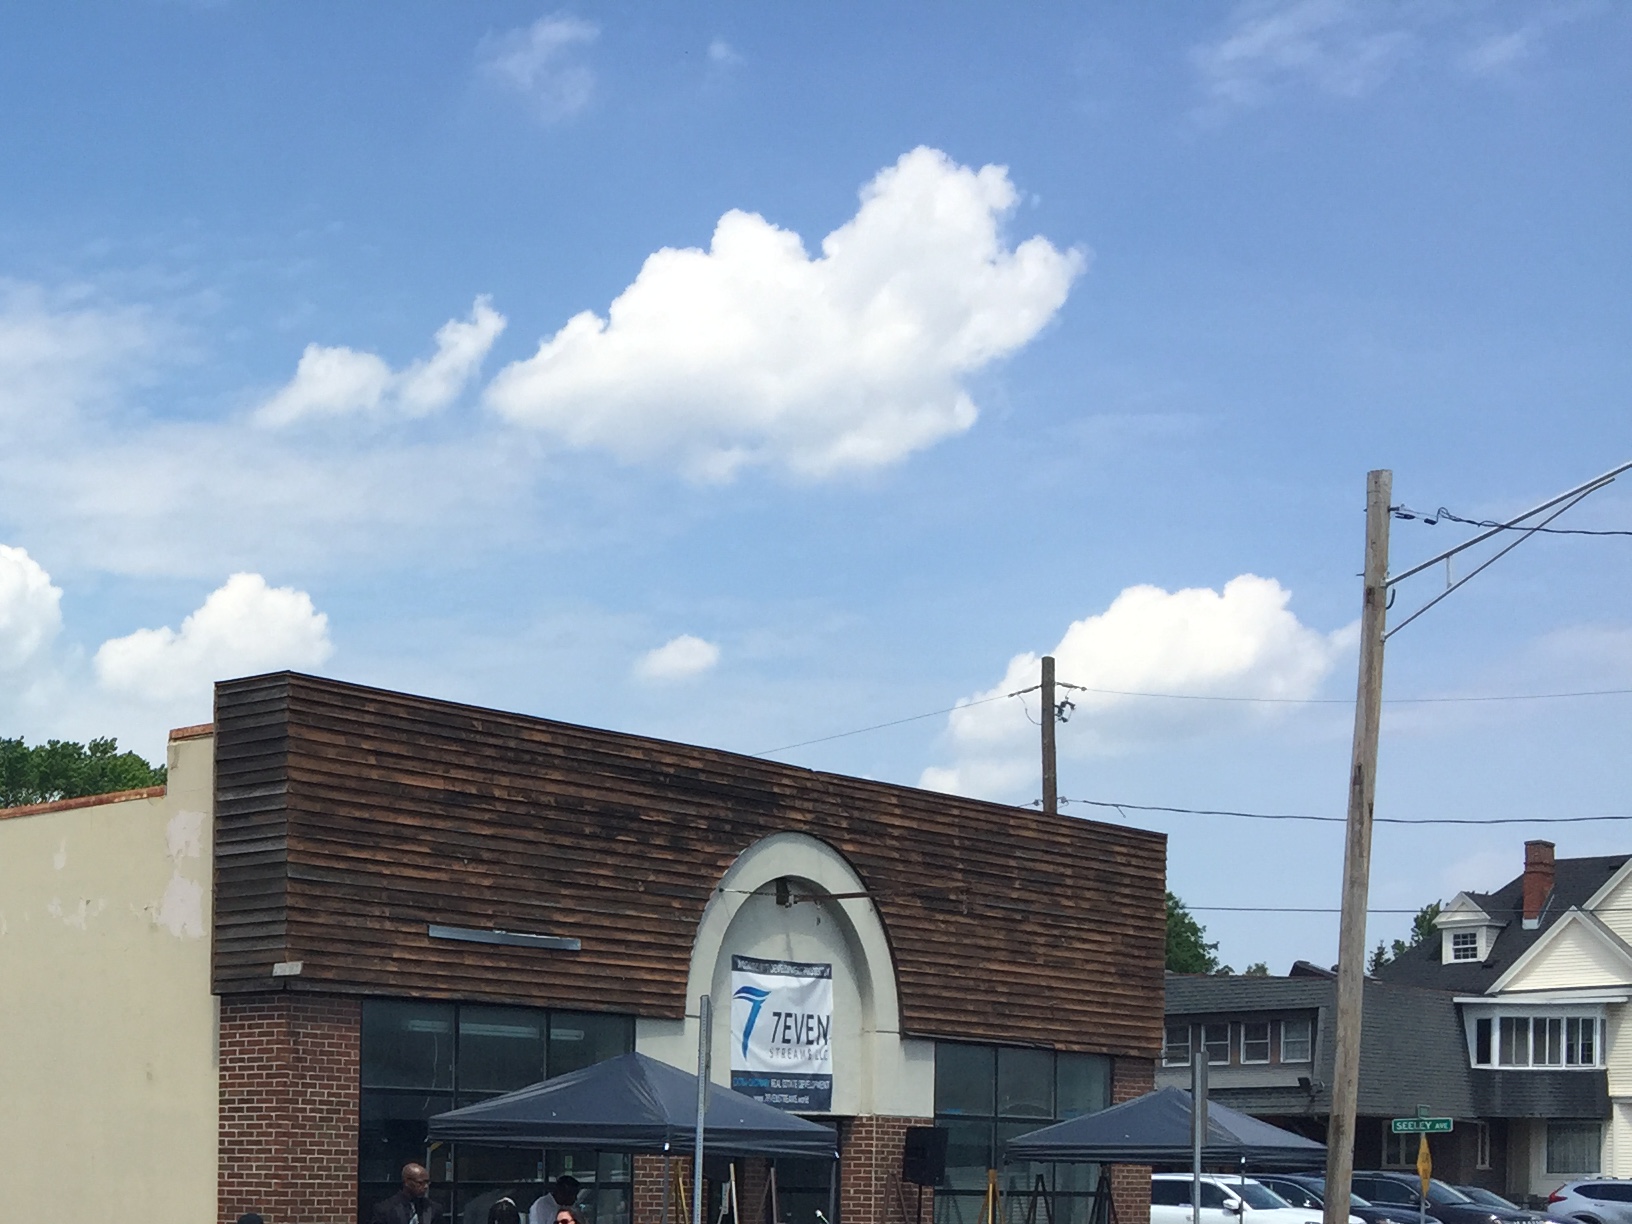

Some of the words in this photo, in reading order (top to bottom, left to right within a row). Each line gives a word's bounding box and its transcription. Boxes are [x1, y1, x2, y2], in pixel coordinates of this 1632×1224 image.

[771, 1011, 830, 1046] 7EVEN
[769, 1047, 812, 1061] STREAMS
[814, 1048, 829, 1061] LLC
[1396, 1121, 1432, 1130] SEELEY
